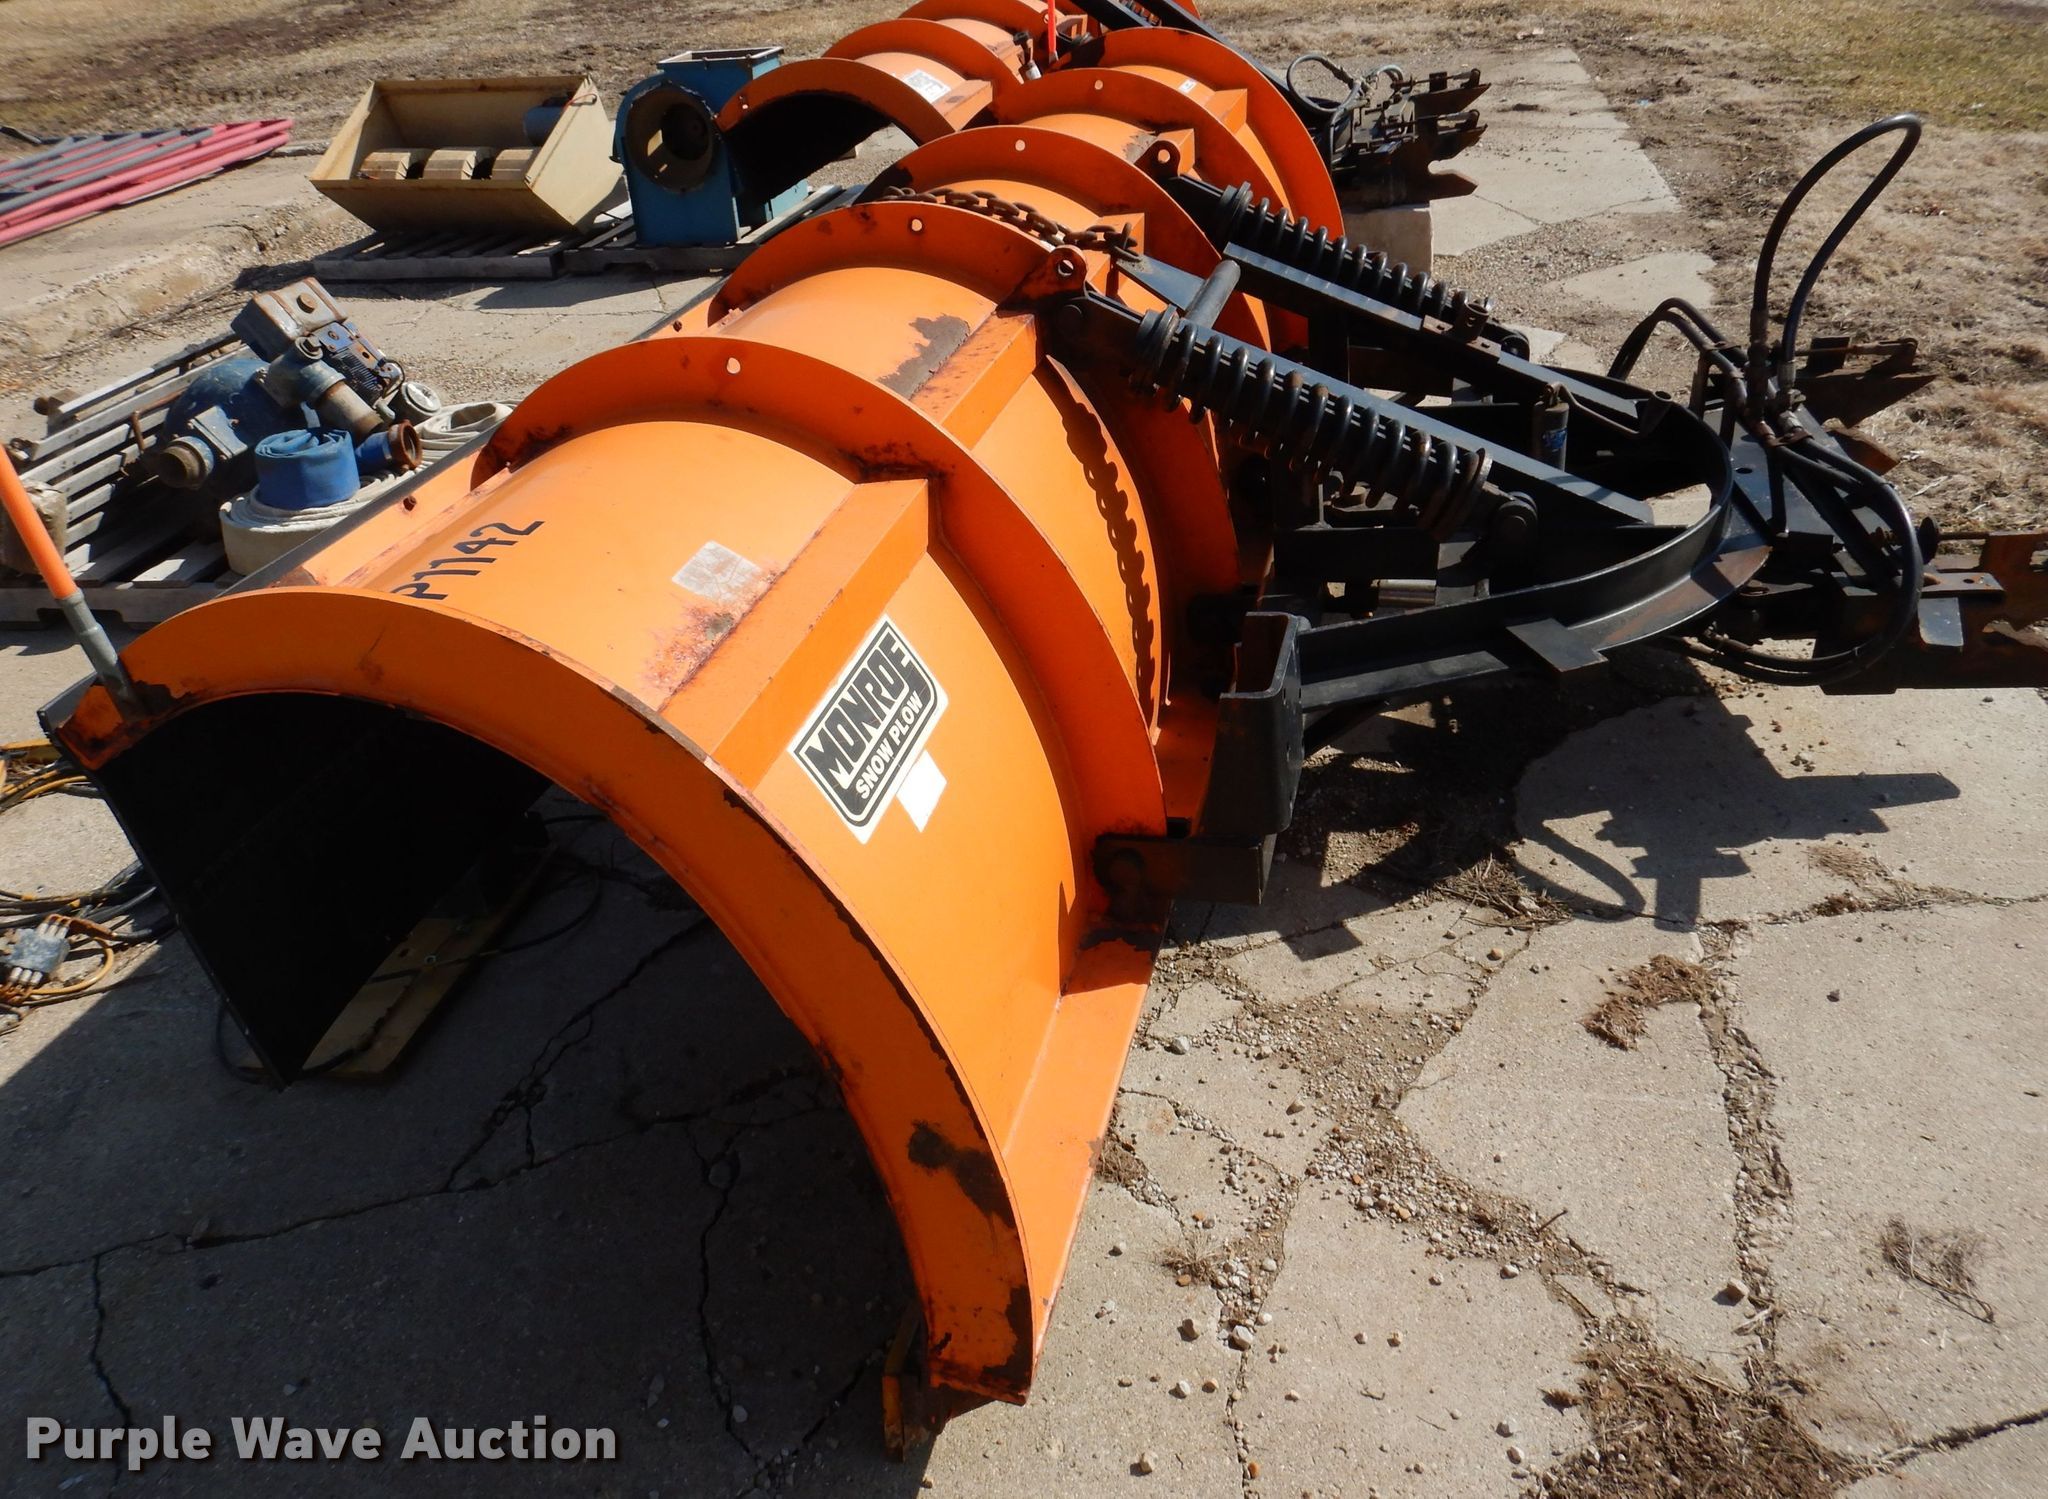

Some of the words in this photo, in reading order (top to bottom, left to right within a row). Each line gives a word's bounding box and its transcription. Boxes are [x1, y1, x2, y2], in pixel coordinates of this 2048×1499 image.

[804, 631, 915, 790] MONROE
[855, 737, 894, 799] SNOW
[888, 690, 923, 746] PLOW
